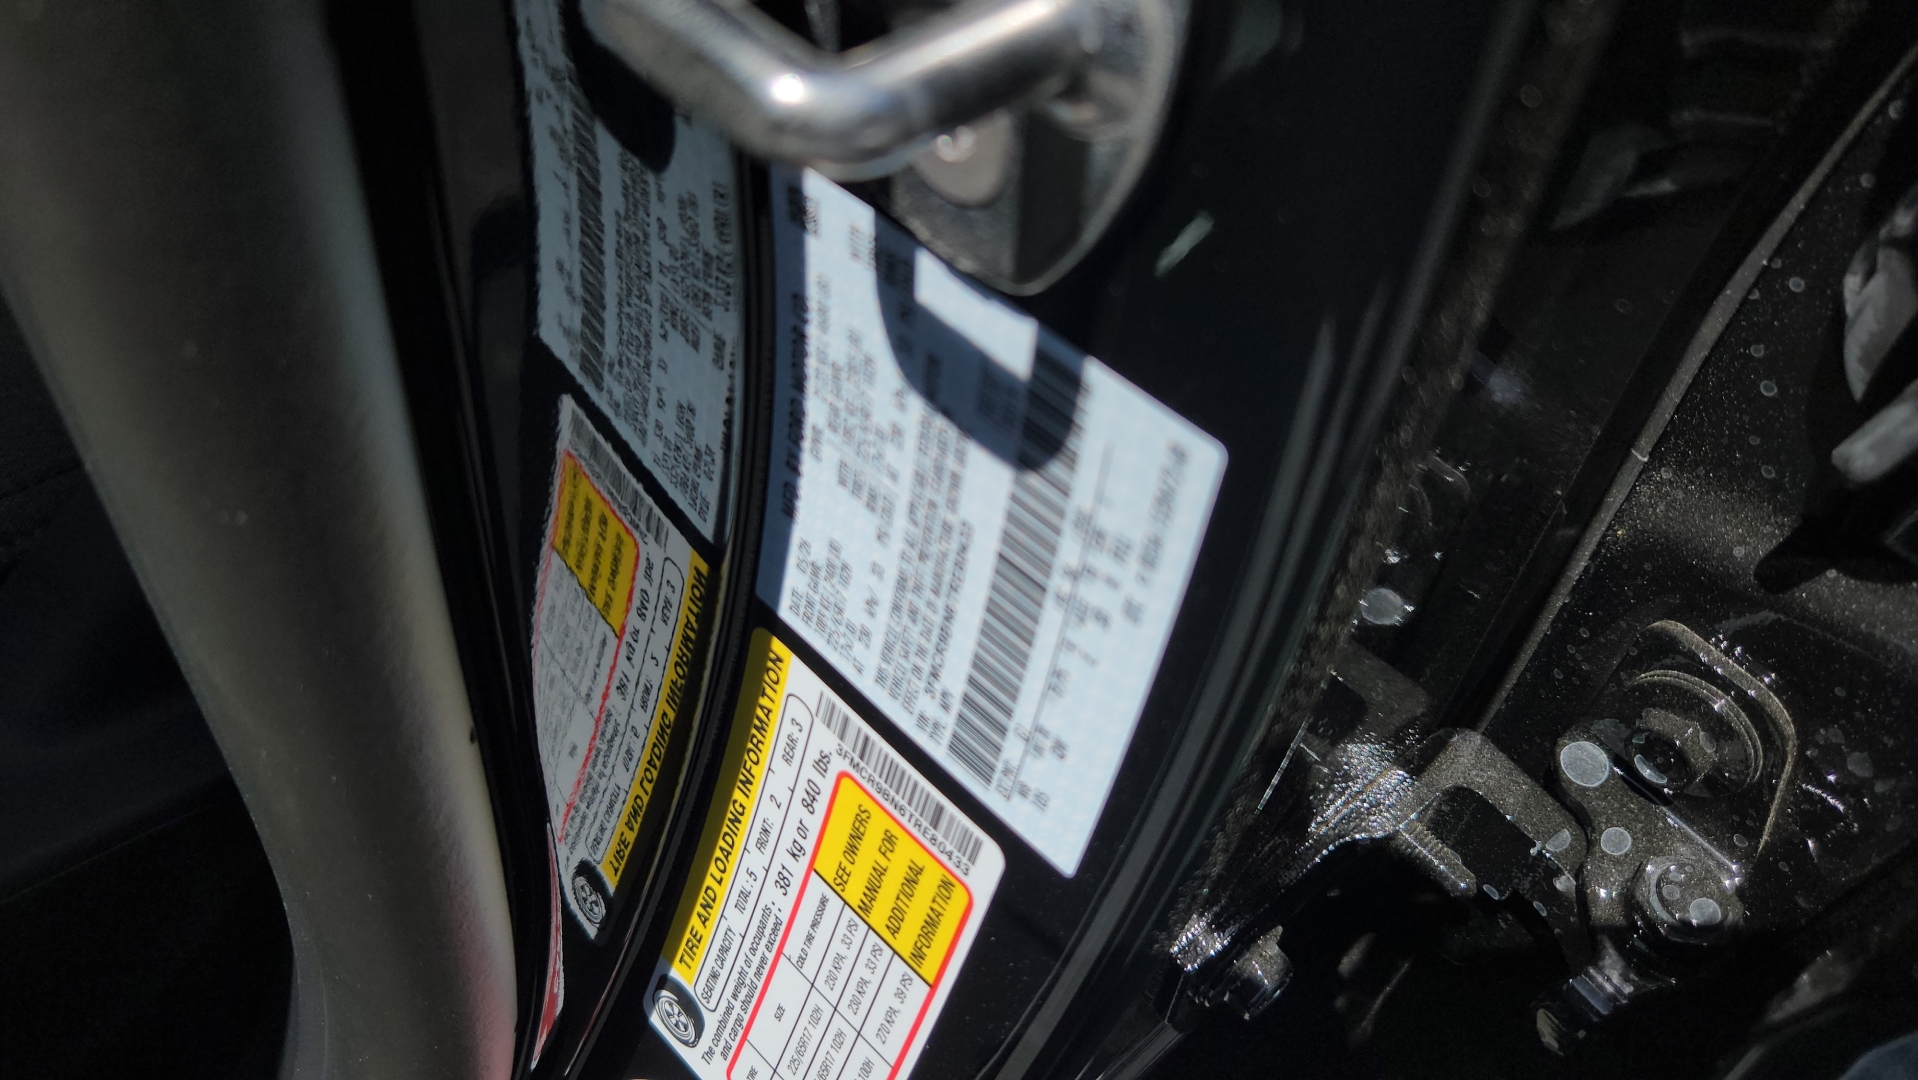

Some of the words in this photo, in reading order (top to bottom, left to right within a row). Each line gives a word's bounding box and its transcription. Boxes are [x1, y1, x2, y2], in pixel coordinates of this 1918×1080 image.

[796, 536, 812, 576] 05/26
[801, 590, 817, 629] FRONT
[824, 587, 850, 653] 225/65R17
[837, 557, 854, 592] 102H
[905, 597, 921, 625] AND
[813, 606, 829, 640] 1089
[853, 655, 865, 675] AT
[859, 623, 872, 649] 230
[879, 620, 899, 667] VEHICLE
[896, 620, 916, 662] SAFETY
[874, 661, 890, 691] THIS
[887, 658, 907, 702] VEHICLE
[909, 658, 924, 681] ON
[782, 733, 799, 766] REAR:
[792, 718, 803, 733] 3
[812, 750, 833, 778] lbs.
[679, 925, 703, 971] TIRE
[697, 886, 717, 928] AND
[711, 799, 746, 887] LOADING
[737, 650, 785, 799] INFORMATION
[802, 779, 821, 814] 840
[836, 742, 971, 877] 3FMCR9BN6TRE80433
[755, 817, 774, 855] FRONT:
[770, 795, 782, 809] 2
[797, 819, 810, 840] or
[786, 838, 806, 862] kg
[833, 861, 848, 893] SEE
[843, 804, 872, 866] OWNERS
[746, 867, 758, 882] 5
[774, 863, 794, 896] 381
[857, 862, 889, 918] MANUAL
[878, 828, 899, 864] FOR
[885, 859, 925, 940] ADDITIONAL
[797, 947, 809, 969] COLD
[803, 929, 816, 952] TIRE
[810, 892, 830, 934] PRESSURE
[846, 917, 860, 938] PSI
[908, 873, 956, 969] INFORMATION
[841, 934, 853, 950] 33
[870, 941, 884, 962] PSI
[701, 966, 719, 1004] SEATING
[714, 925, 736, 970] CAPACITY
[824, 969, 838, 991] 230
[865, 958, 877, 975] 33
[900, 971, 915, 992] PSI
[701, 1045, 715, 1065] The
[711, 998, 735, 1047] combined
[731, 967, 749, 1002] weight
[744, 952, 753, 969] of
[749, 904, 773, 957] occupants
[720, 1037, 733, 1061] and
[728, 1013, 744, 1042] cargo
[740, 980, 758, 1015] should
[753, 951, 769, 983] never
[765, 913, 783, 953] exceed
[894, 987, 907, 1005] 39
[774, 1003, 786, 1023] SIZE
[848, 993, 862, 1016] 230
[787, 1027, 813, 1076] 225/65R17
[808, 1003, 824, 1030] 102H
[875, 1023, 891, 1045] 270
[814, 1051, 836, 1080] /65R17
[831, 1027, 847, 1054] 102H
[858, 1056, 875, 1080] 100H
[746, 1065, 759, 1080] TIRE
